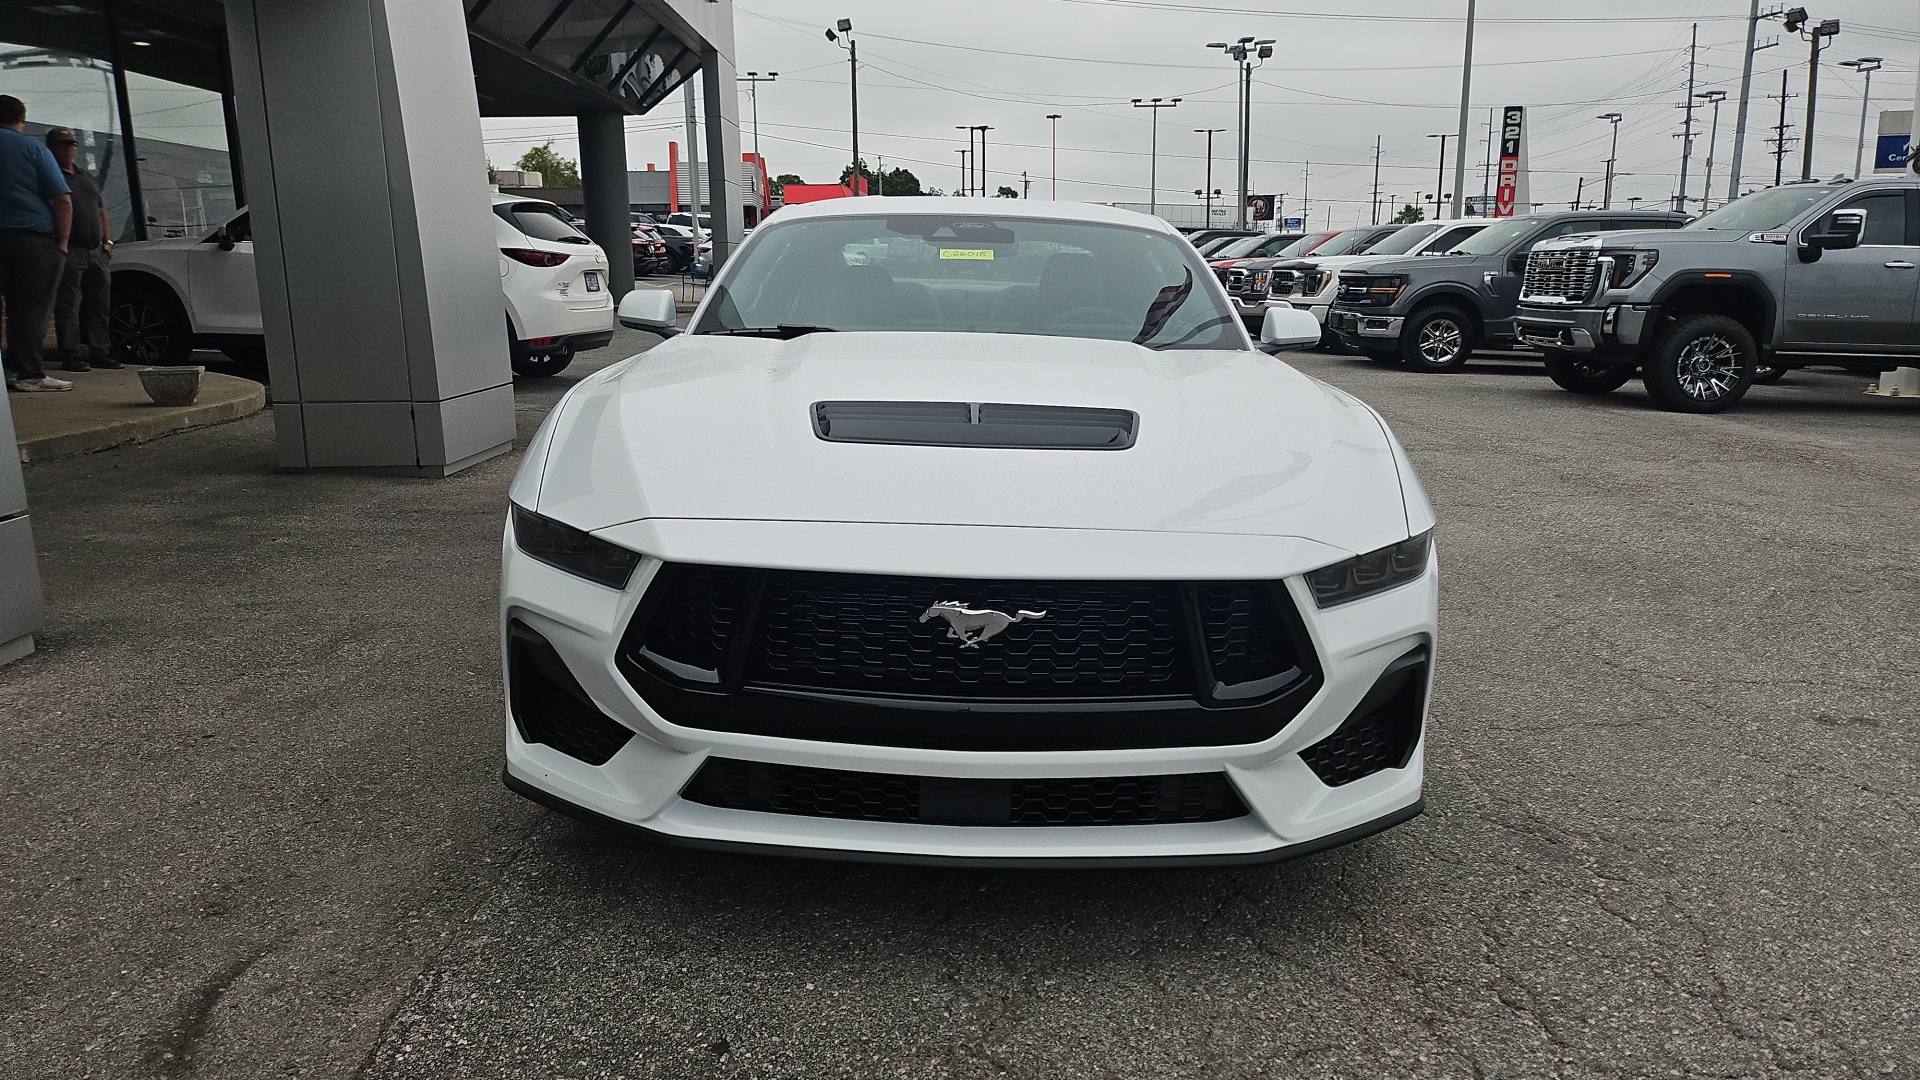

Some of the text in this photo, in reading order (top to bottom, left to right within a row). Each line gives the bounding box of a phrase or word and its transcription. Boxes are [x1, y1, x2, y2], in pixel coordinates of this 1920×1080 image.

[1496, 111, 1521, 218] 321 DRIV
[1888, 153, 1907, 162] Cer
